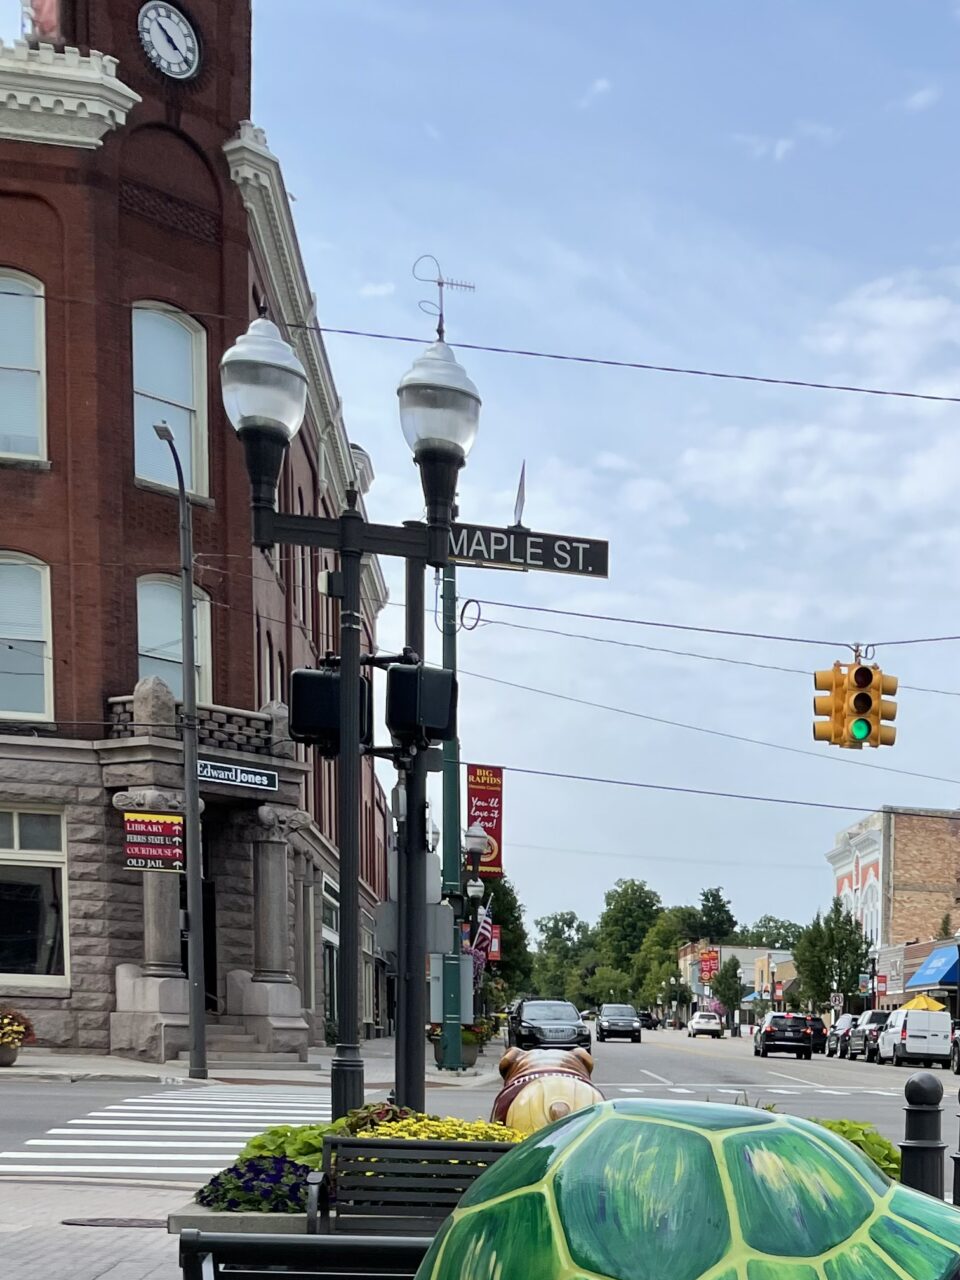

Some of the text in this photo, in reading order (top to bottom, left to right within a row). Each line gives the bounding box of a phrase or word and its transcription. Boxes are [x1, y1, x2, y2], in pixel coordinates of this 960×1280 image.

[449, 527, 593, 572] MAPLE ST.
[476, 769, 493, 777] BIG
[468, 775, 502, 784] RAPIDS
[471, 797, 499, 808] You'll
[126, 823, 163, 833] LIBRARY
[127, 834, 147, 843] FERRIS
[147, 835, 165, 845] STATE
[126, 847, 173, 857] COURTHOUSE
[127, 858, 164, 869] OLD JAIL
